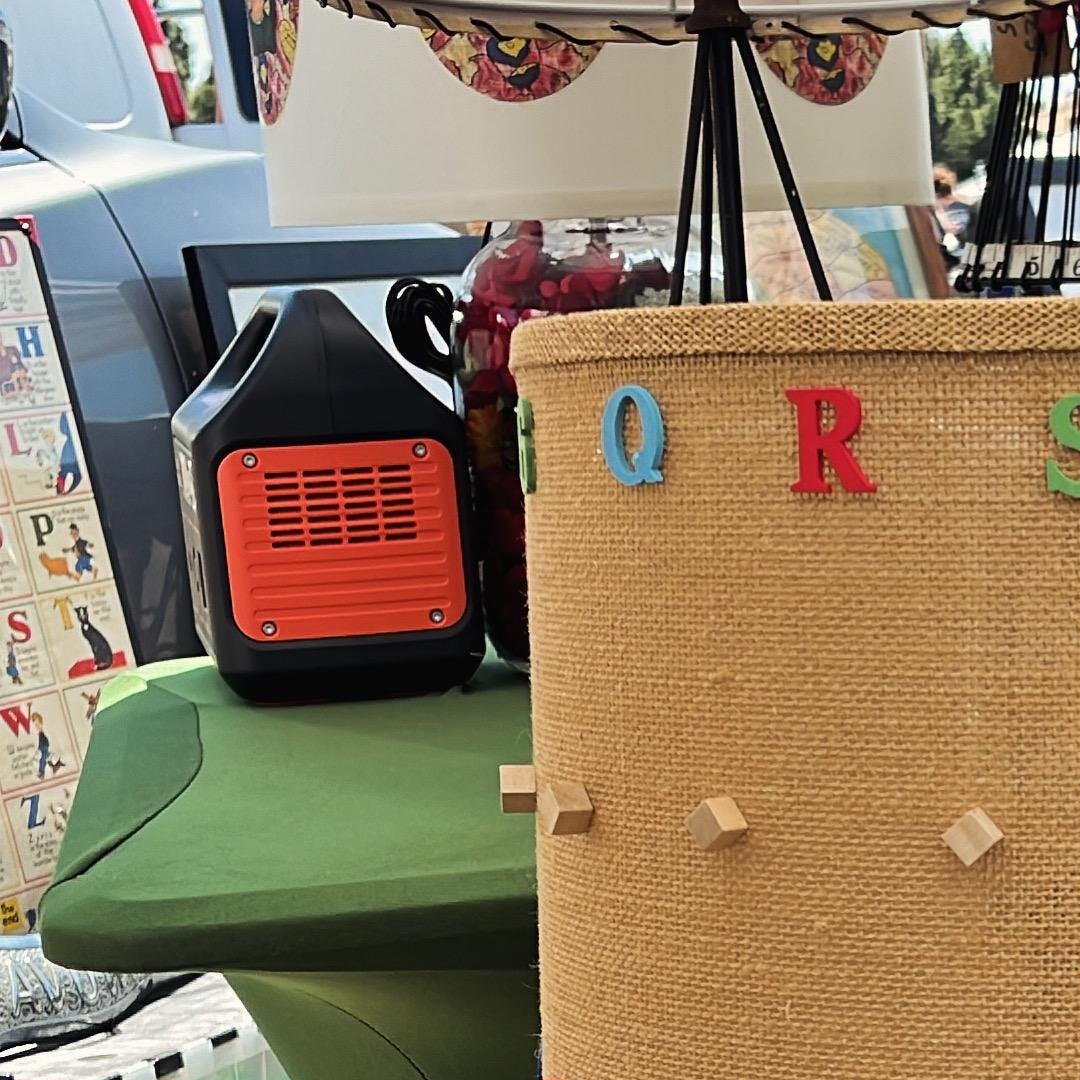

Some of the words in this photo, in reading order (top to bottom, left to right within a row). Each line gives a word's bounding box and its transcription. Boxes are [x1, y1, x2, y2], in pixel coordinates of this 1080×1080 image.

[16, 326, 44, 358] H
[5, 424, 32, 456] L
[601, 385, 664, 486] Q
[786, 389, 877, 494] R
[30, 513, 54, 547] P
[8, 610, 32, 643] S
[53, 595, 74, 631] T
[0, 702, 32, 738] W
[20, 794, 46, 830] Z
